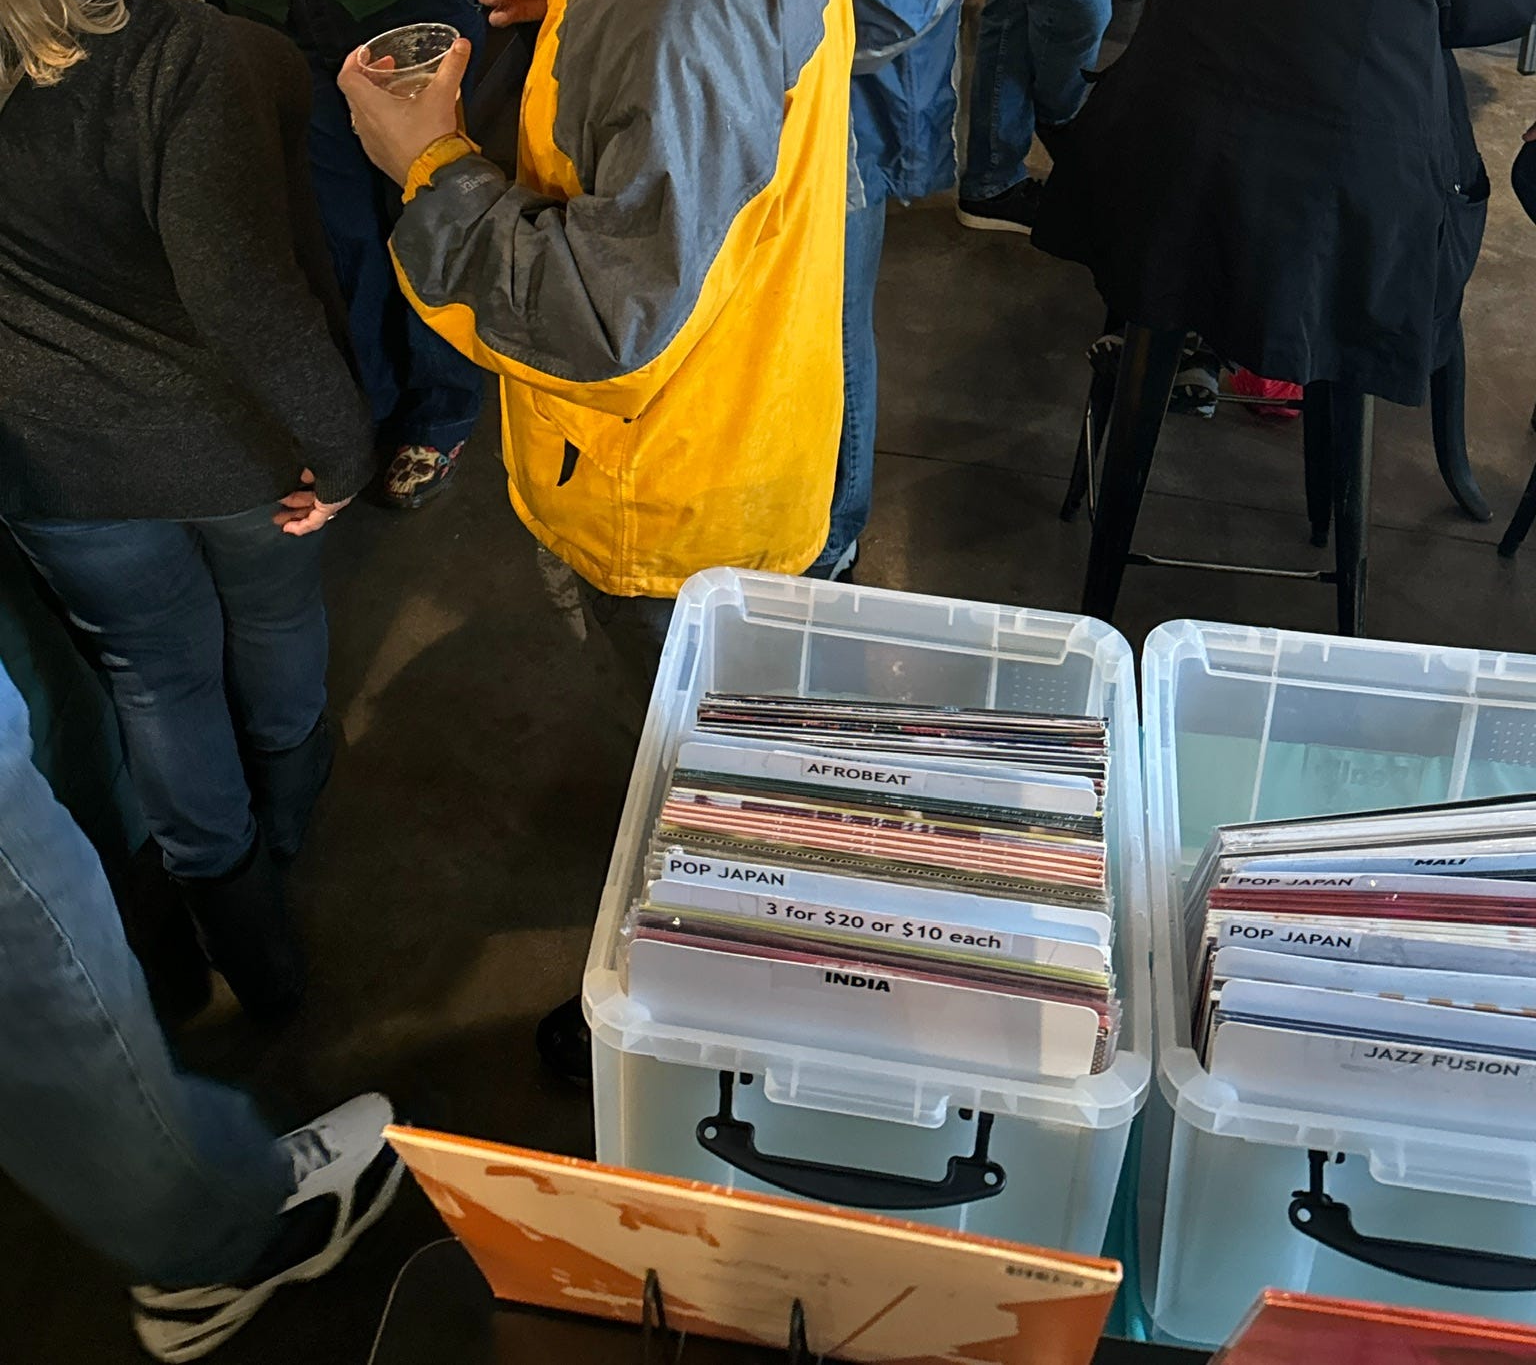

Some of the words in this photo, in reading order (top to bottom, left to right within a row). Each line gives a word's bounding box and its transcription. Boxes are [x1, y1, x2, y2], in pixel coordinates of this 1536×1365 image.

[807, 763, 911, 785] AFROBEAT
[670, 859, 711, 876] POP
[718, 867, 785, 886] JAPAN
[1414, 858, 1467, 866] MALI
[1238, 877, 1280, 885] POP
[1285, 878, 1354, 886] JAPAN
[766, 902, 777, 915] 3
[785, 905, 816, 921] for
[824, 910, 864, 929] $20
[871, 921, 894, 933] or
[902, 921, 942, 940] $10
[949, 933, 1001, 949] each
[1229, 925, 1274, 940] POP
[1280, 932, 1352, 948] JAPAN
[825, 971, 891, 993] INDIA
[1364, 1046, 1423, 1064] JAZZ
[1431, 1054, 1521, 1076] FUSION
